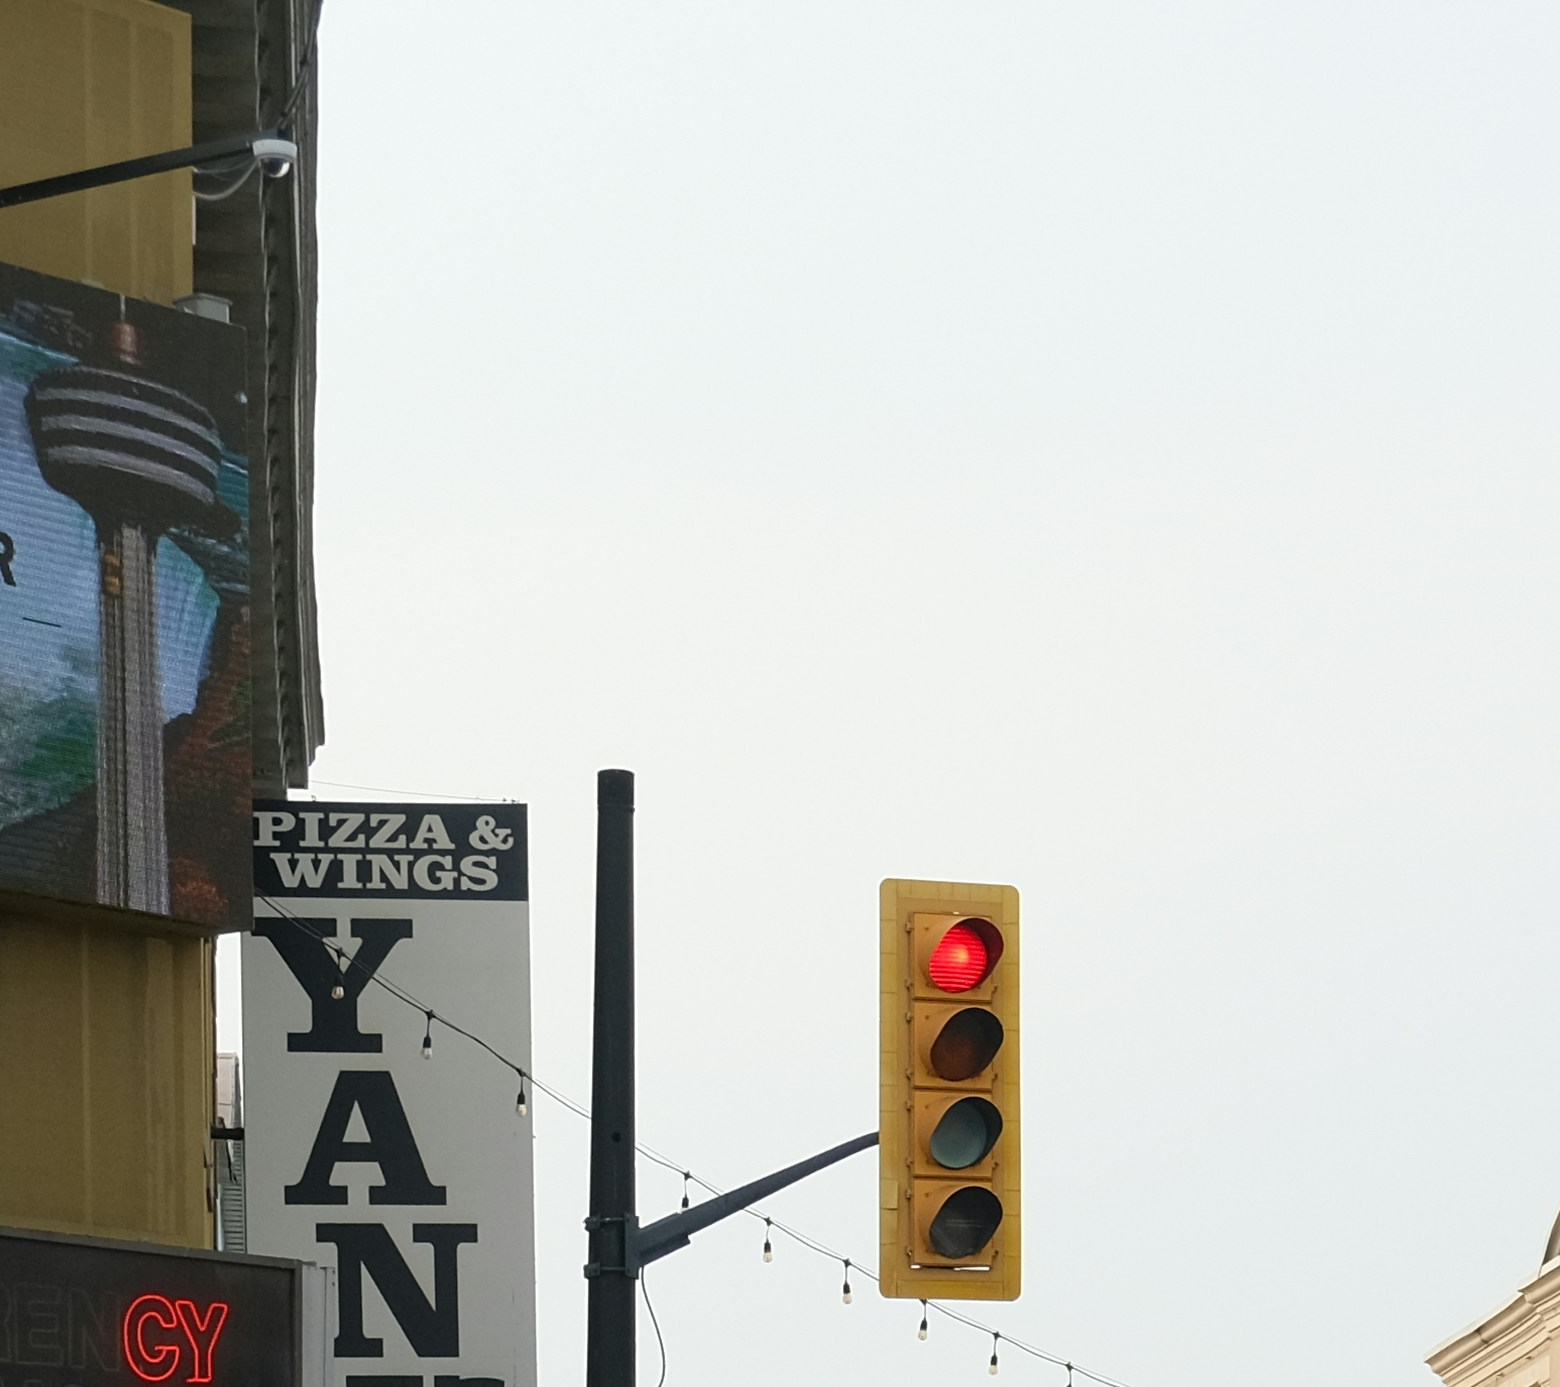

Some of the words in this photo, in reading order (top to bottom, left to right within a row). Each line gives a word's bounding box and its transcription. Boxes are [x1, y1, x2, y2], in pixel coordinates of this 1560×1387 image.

[252, 812, 455, 851] PIZZA
[469, 815, 515, 851] &
[270, 852, 500, 892] WINGS
